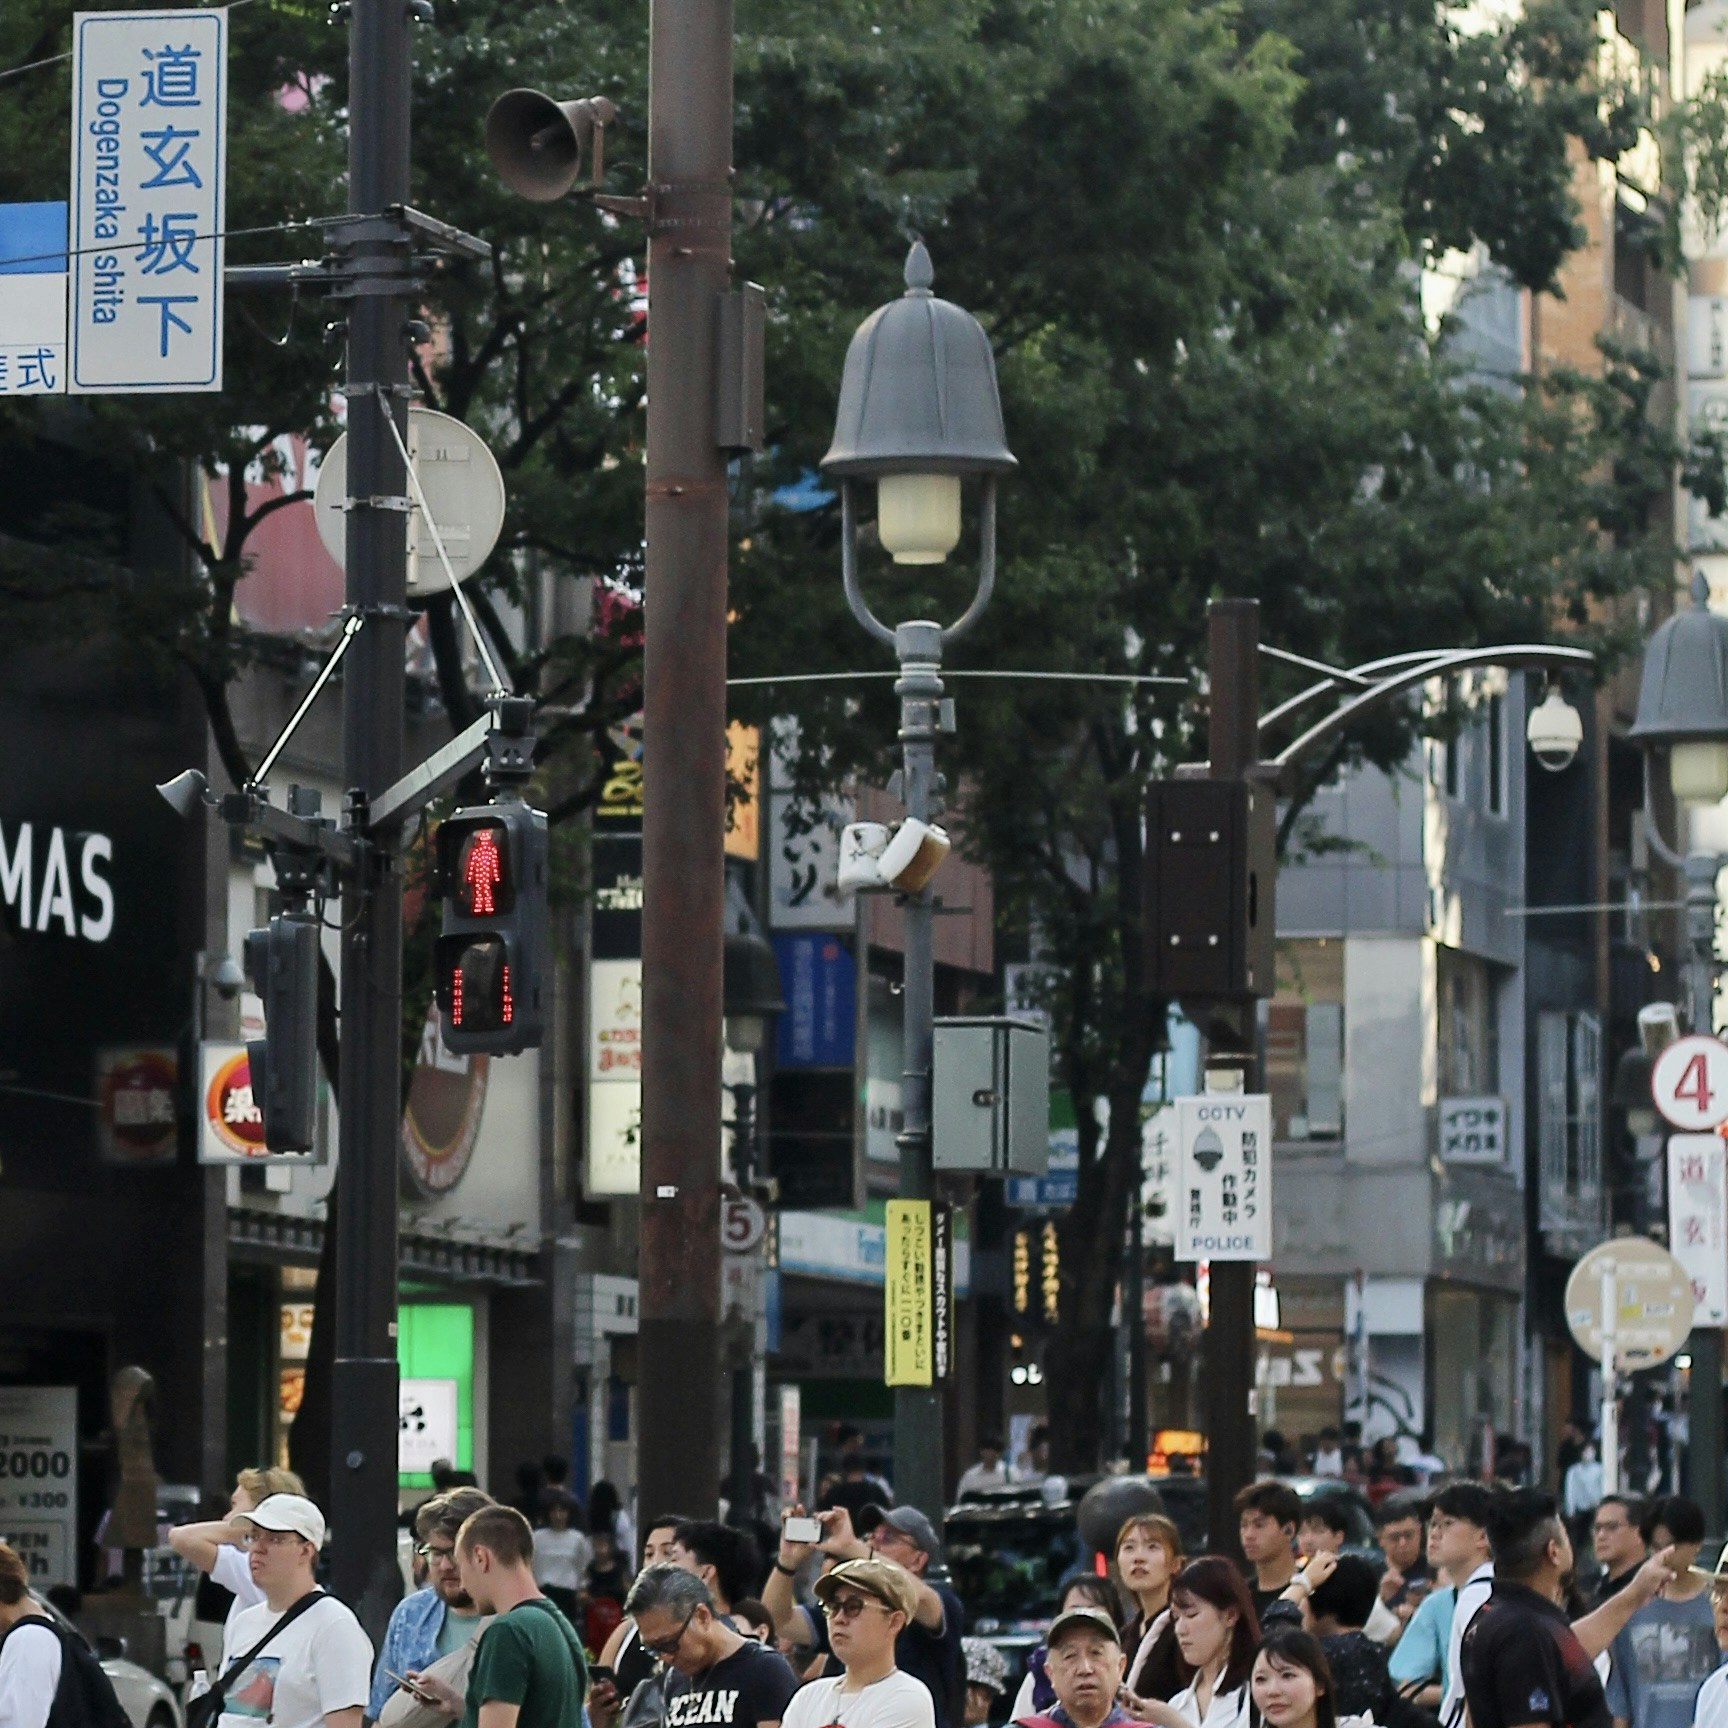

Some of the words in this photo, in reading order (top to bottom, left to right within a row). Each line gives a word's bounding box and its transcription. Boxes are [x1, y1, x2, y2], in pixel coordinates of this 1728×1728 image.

[91, 78, 129, 239] Dogenzaka
[135, 43, 203, 358] 道玄坂下
[92, 255, 126, 324] shita
[1198, 1106, 1247, 1121] CCTV
[1675, 1054, 1714, 1112] 4
[1241, 1131, 1258, 1219] 防犯カメラ
[727, 1203, 750, 1239] 5
[1191, 1235, 1255, 1251] POLICE
